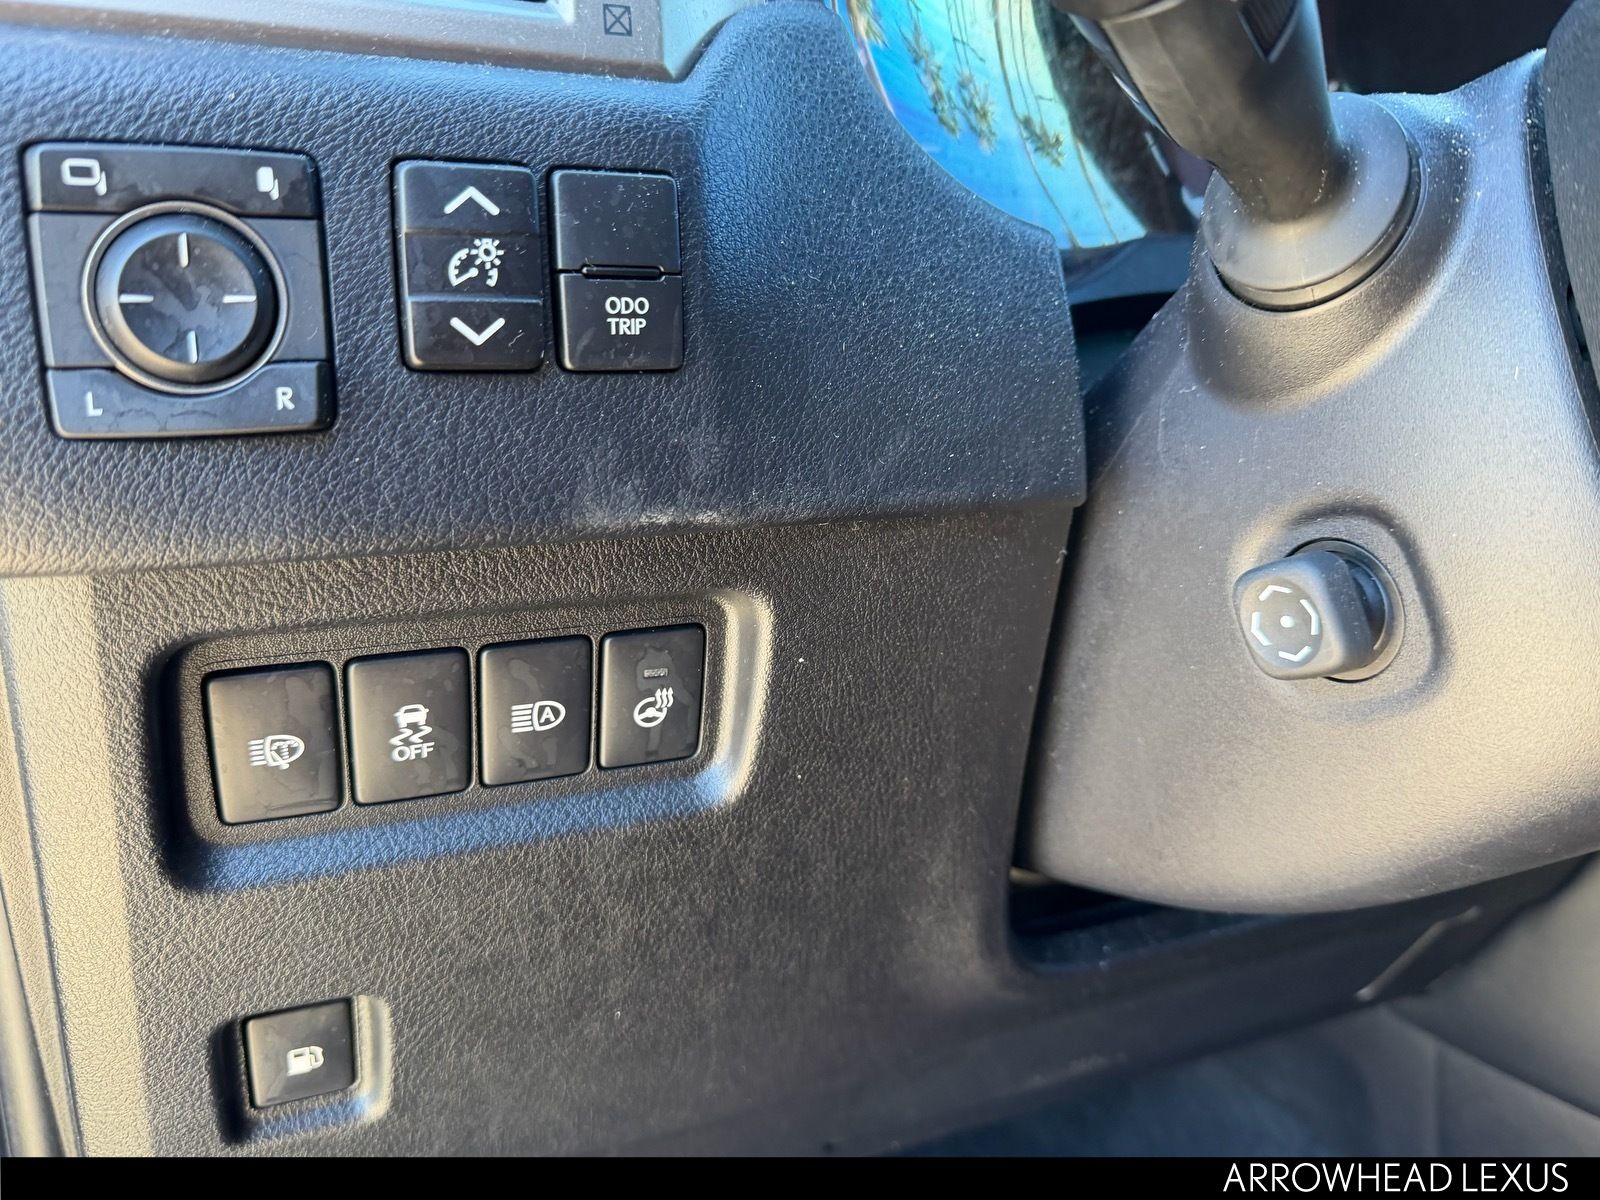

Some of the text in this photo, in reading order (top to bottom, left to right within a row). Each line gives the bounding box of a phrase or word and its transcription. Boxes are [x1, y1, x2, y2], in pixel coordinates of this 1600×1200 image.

[605, 296, 650, 315] ODO
[606, 317, 647, 336] TRIP
[85, 391, 104, 417] L
[276, 386, 295, 411] R
[539, 706, 556, 724] A
[391, 742, 435, 762] OFF
